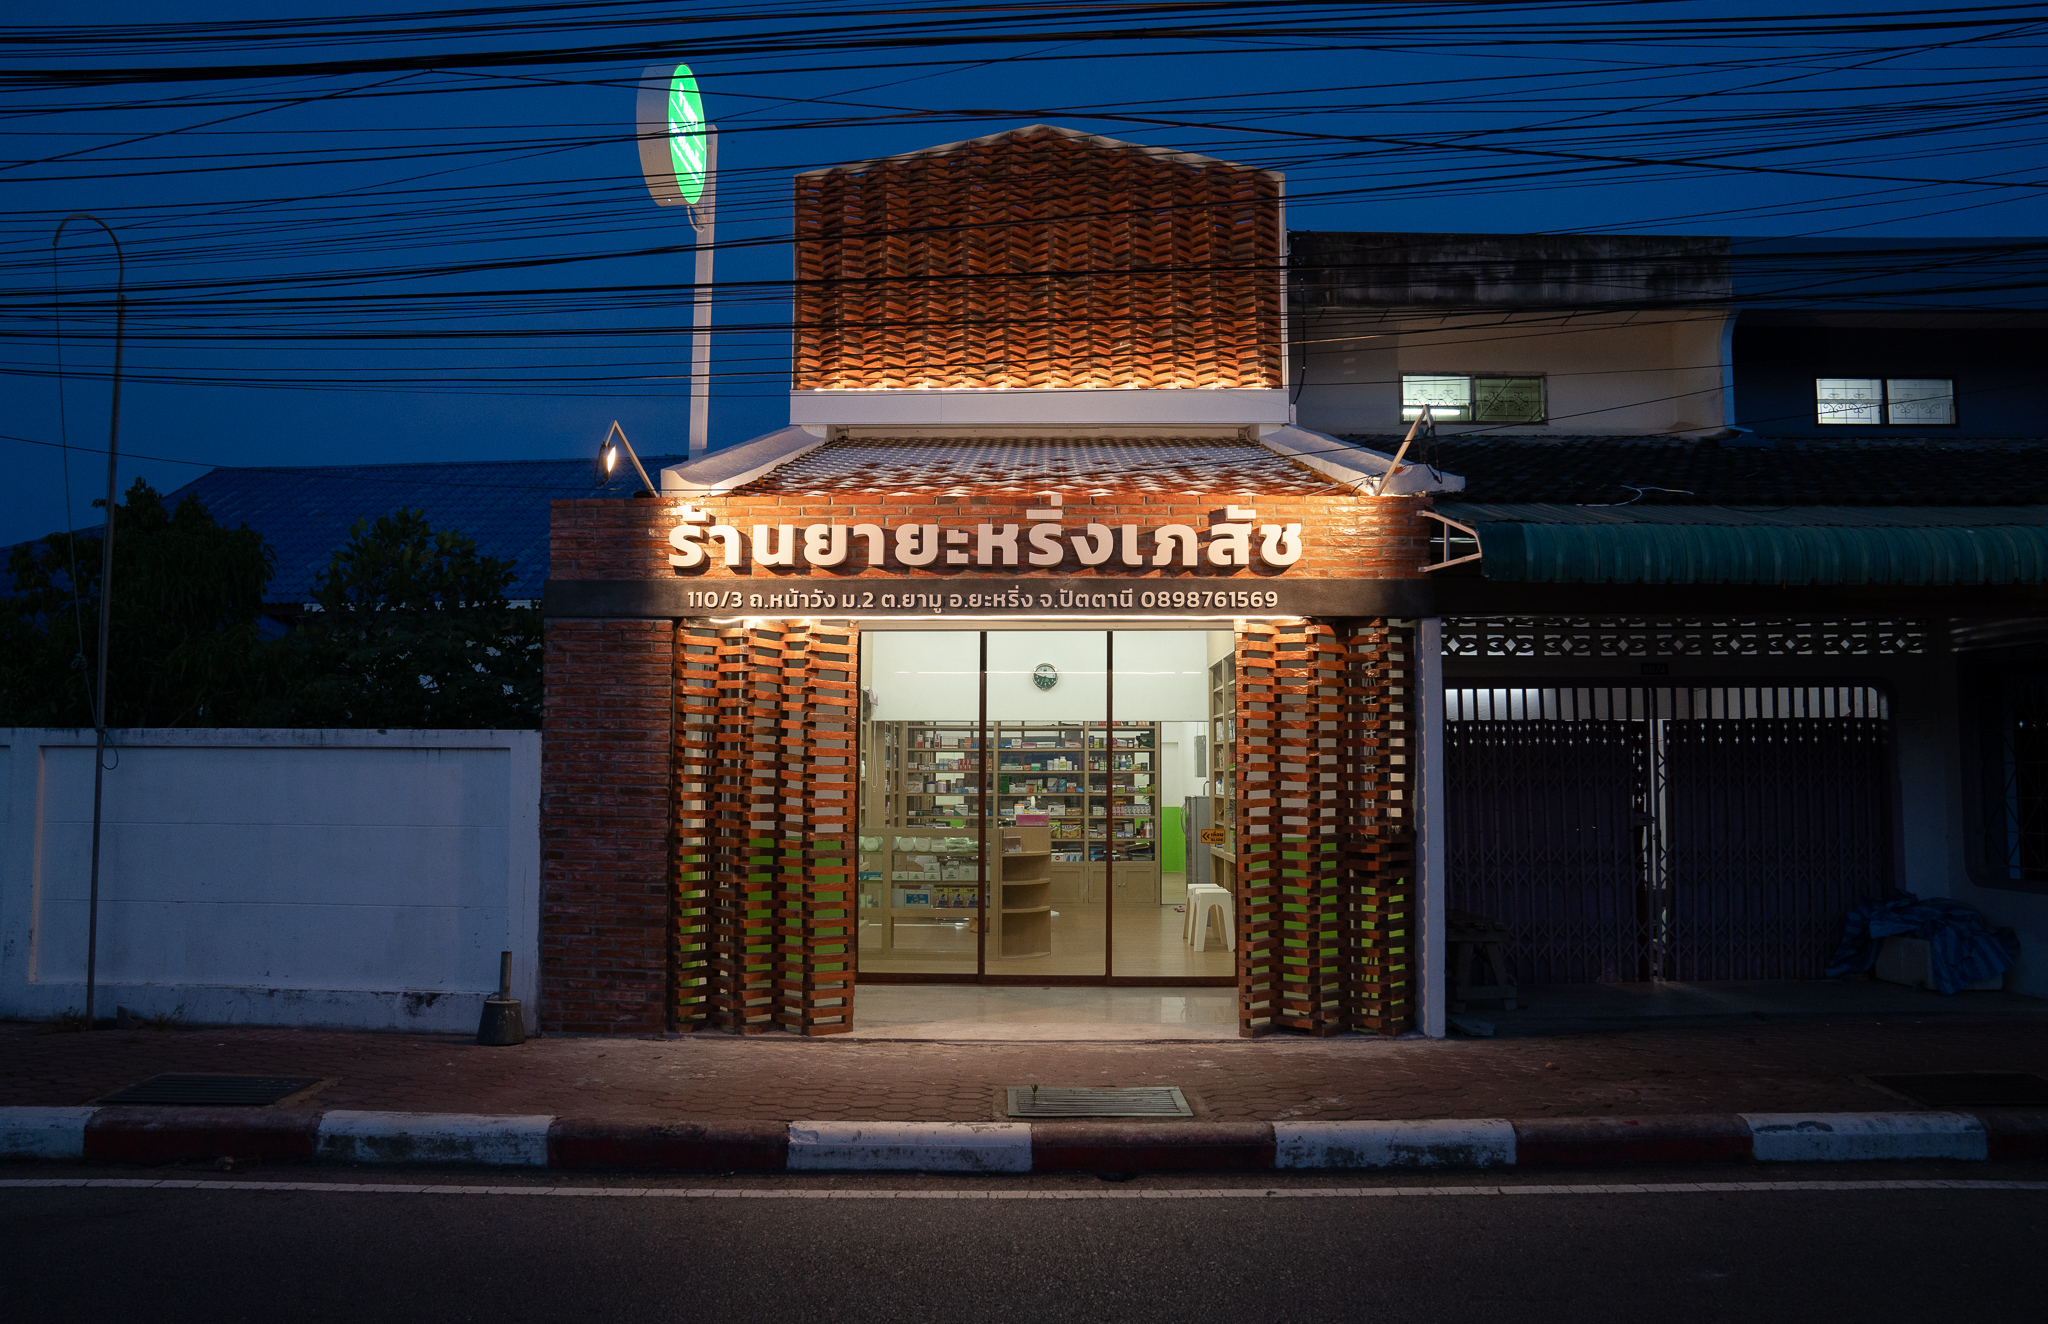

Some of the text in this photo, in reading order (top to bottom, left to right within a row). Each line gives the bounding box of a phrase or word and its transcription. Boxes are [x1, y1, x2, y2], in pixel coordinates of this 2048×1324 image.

[668, 495, 1303, 568] ร้านยายะหริ่งเภสัช
[687, 585, 1278, 614] 110/3 ถ.หน้าวัง ม.2 ต.ยามู อ.ยะหริ่ง จ.ปัตตานี 0898761569
